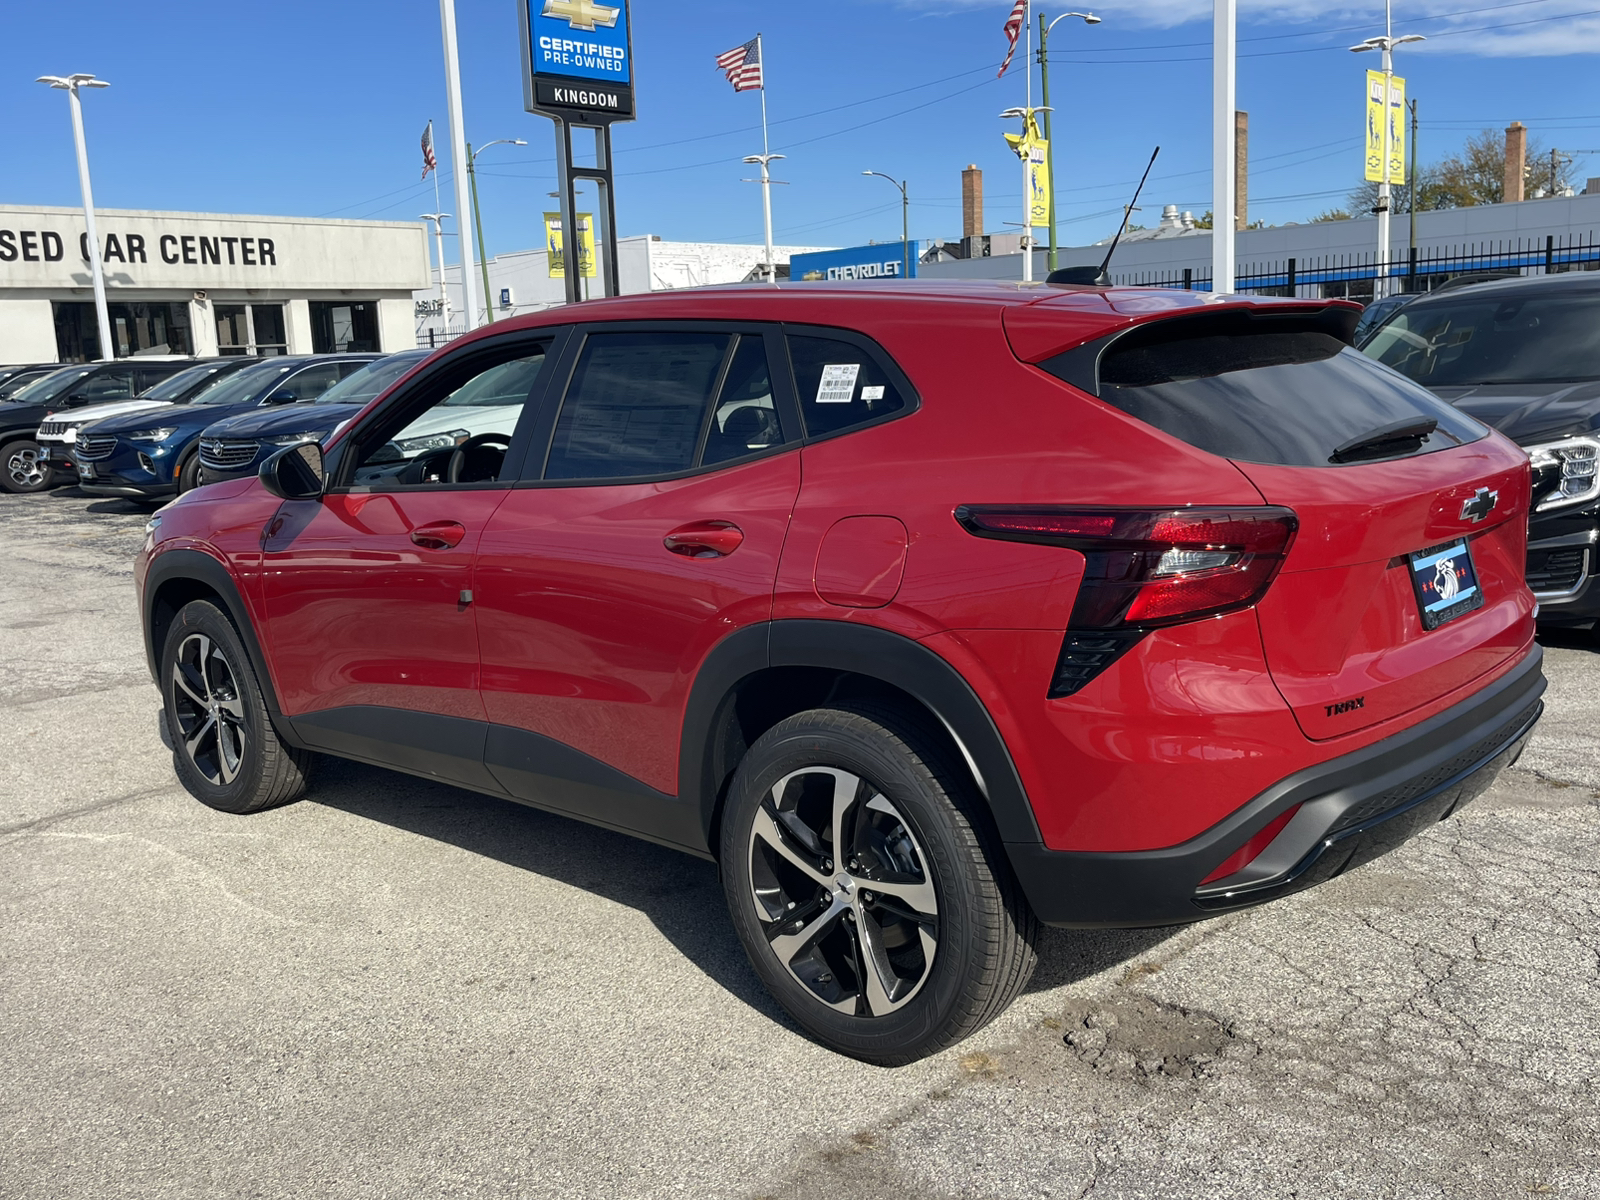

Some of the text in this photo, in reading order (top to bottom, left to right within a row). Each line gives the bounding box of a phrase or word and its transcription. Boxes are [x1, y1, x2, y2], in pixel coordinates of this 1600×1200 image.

[540, 36, 625, 59] CERTIFIED
[543, 50, 622, 72] PRE-OWNED
[554, 88, 618, 108] KINGDOM
[160, 234, 276, 266] CENTER
[827, 260, 902, 280] CHEVROLET
[1324, 696, 1365, 717] TRAX
[926, 828, 962, 977] GOODYEAR
